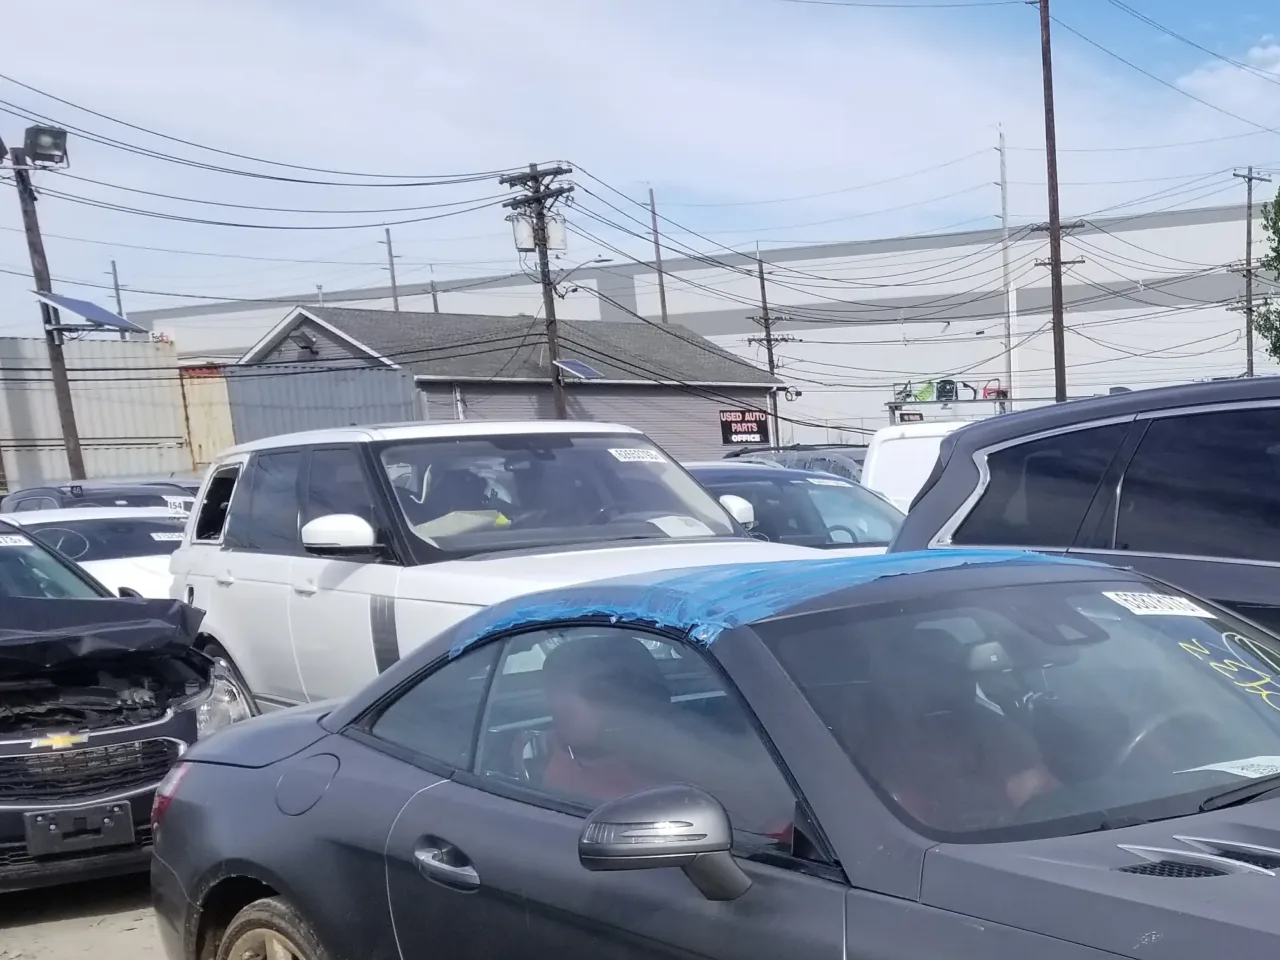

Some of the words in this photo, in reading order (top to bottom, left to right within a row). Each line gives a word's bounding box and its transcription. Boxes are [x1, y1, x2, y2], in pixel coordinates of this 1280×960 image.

[720, 411, 743, 421] USED
[744, 411, 767, 421] AUTO
[731, 422, 758, 432] PARTS
[731, 434, 761, 442] OFFICE
